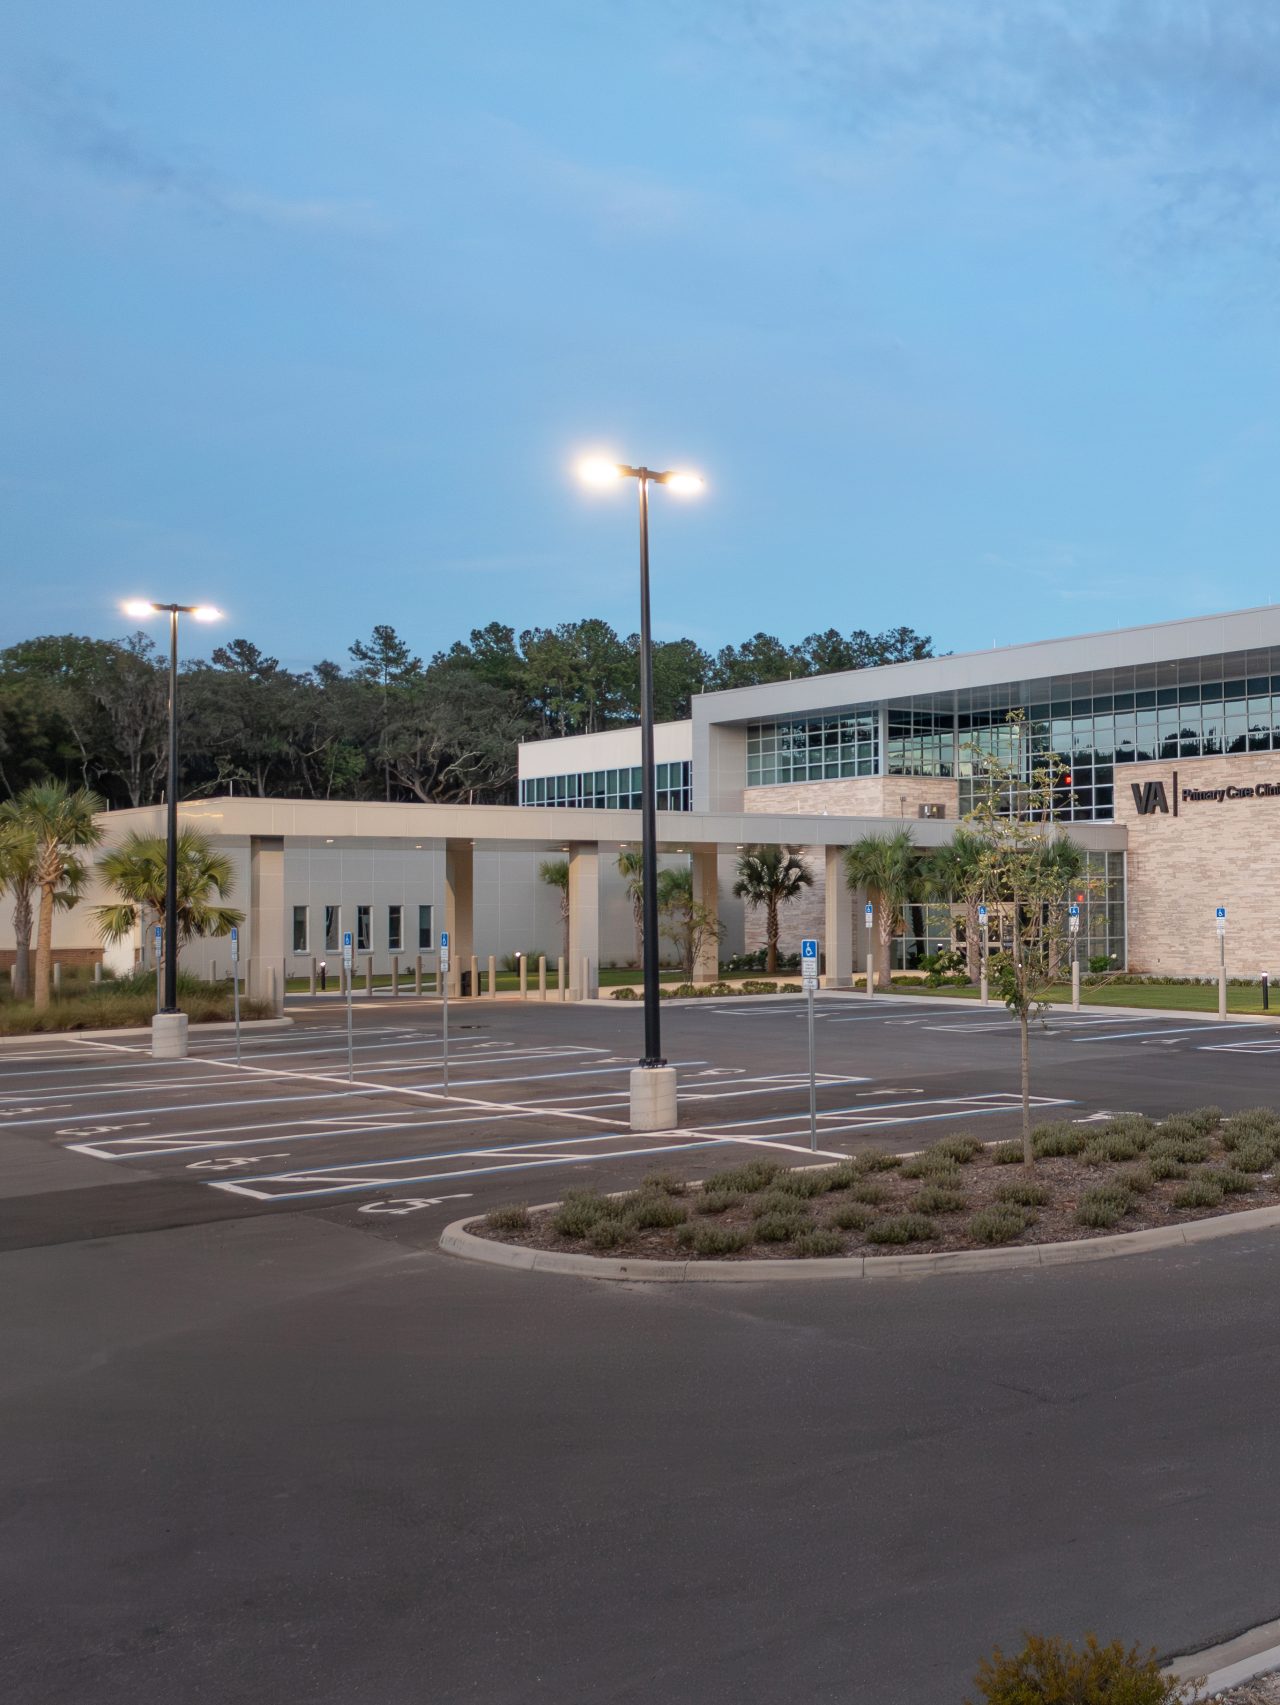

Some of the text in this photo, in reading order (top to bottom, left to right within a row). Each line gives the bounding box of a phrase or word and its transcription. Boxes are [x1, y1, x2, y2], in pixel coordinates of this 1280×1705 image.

[1131, 781, 1169, 815] VA
[1182, 789, 1225, 802] Primary
[1226, 786, 1254, 799] Care
